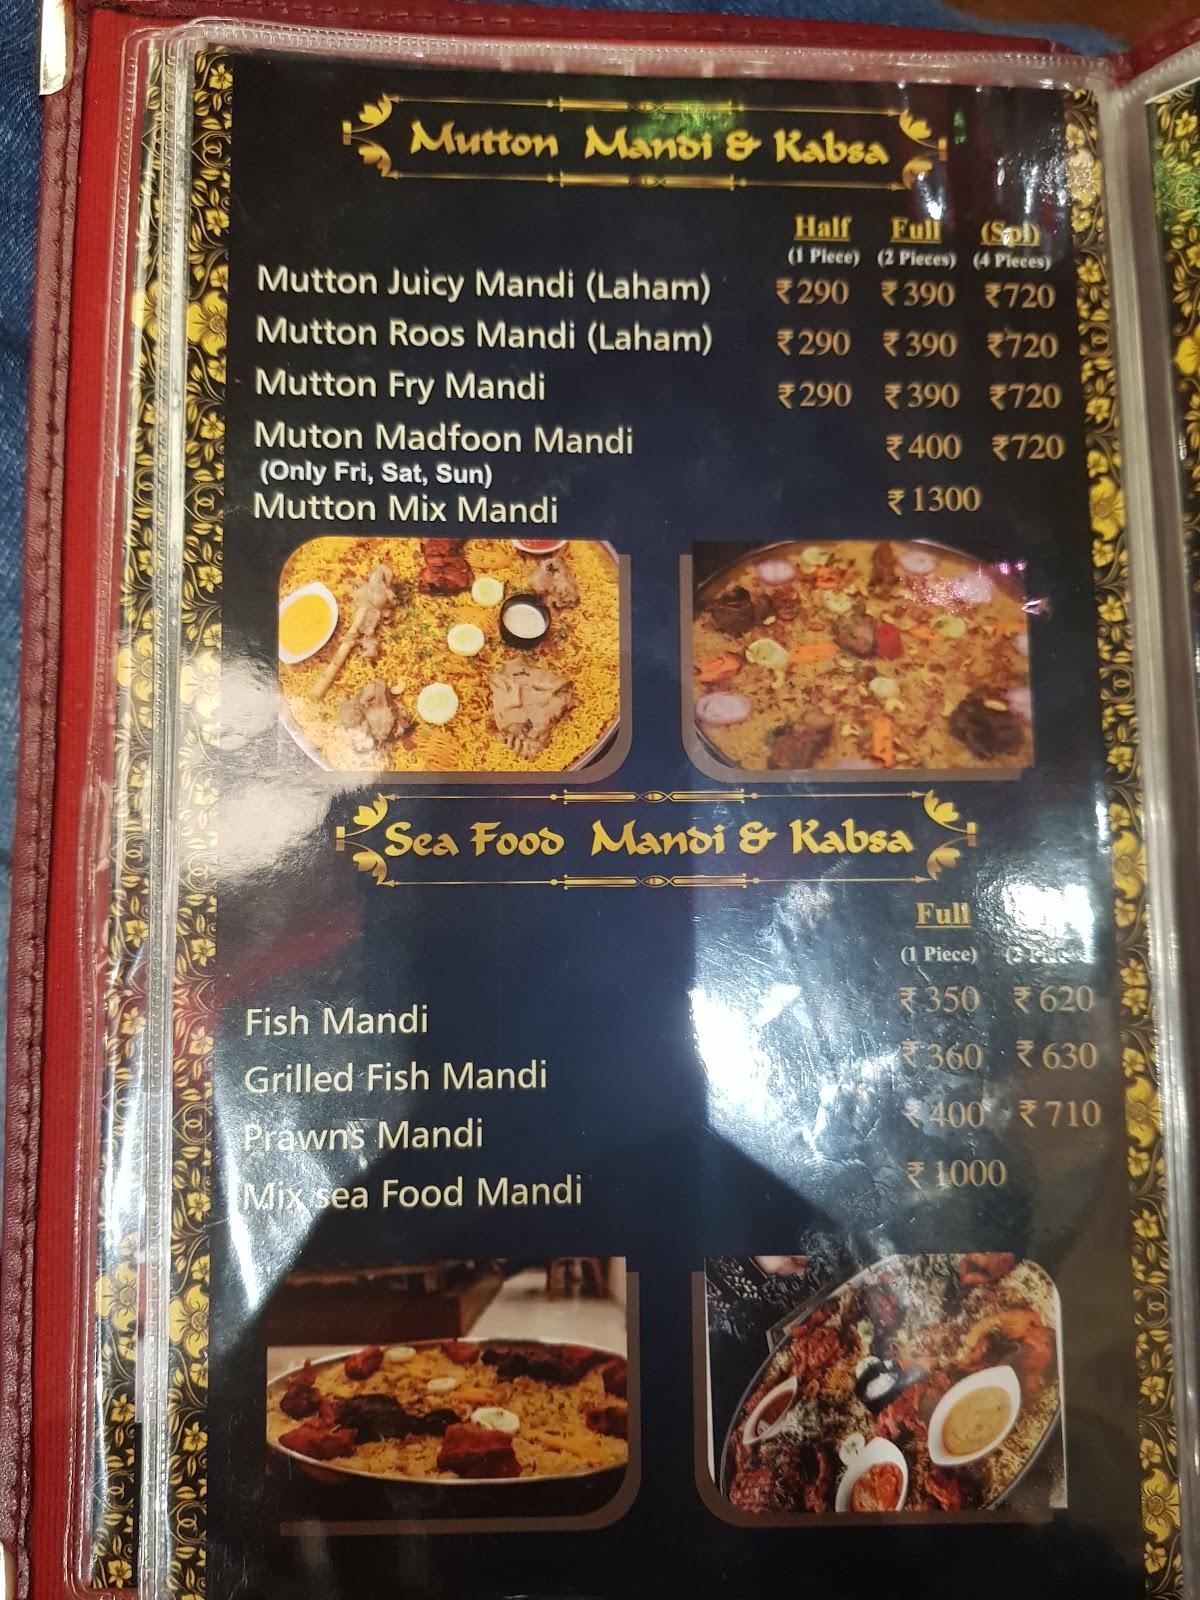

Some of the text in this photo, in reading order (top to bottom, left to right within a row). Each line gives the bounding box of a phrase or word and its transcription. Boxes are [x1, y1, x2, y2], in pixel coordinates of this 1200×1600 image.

[411, 120, 890, 164] Mutton Mandi & Kabsa
[794, 215, 852, 239] Half
[892, 218, 942, 241] Full
[788, 247, 860, 267] (1 Piece)
[877, 249, 957, 270] (2 Pieces)
[973, 252, 1053, 271] (4 Pieces)
[257, 265, 711, 305] Mutton Juicy Mandi (Laham)
[256, 316, 713, 356] Mutton Roos Mandi (Laham)
[255, 368, 545, 404] Mutton Fry Mandi
[254, 421, 633, 455] Muton Madfoon Mandi
[260, 460, 493, 488] (Only Fri, Sat, Sun)
[253, 492, 558, 524] Mutton Mix Mandi
[384, 818, 914, 857] Sea Food Mandi & Kabsa
[916, 903, 971, 926] Full
[901, 947, 978, 965] (1 Piece)
[245, 1004, 428, 1036] Fish Mandi
[244, 1060, 547, 1094] Grilled Fish Mandi
[243, 1117, 483, 1152] Prawns Mandi
[242, 1174, 582, 1210] Mix sea Food Mandi
